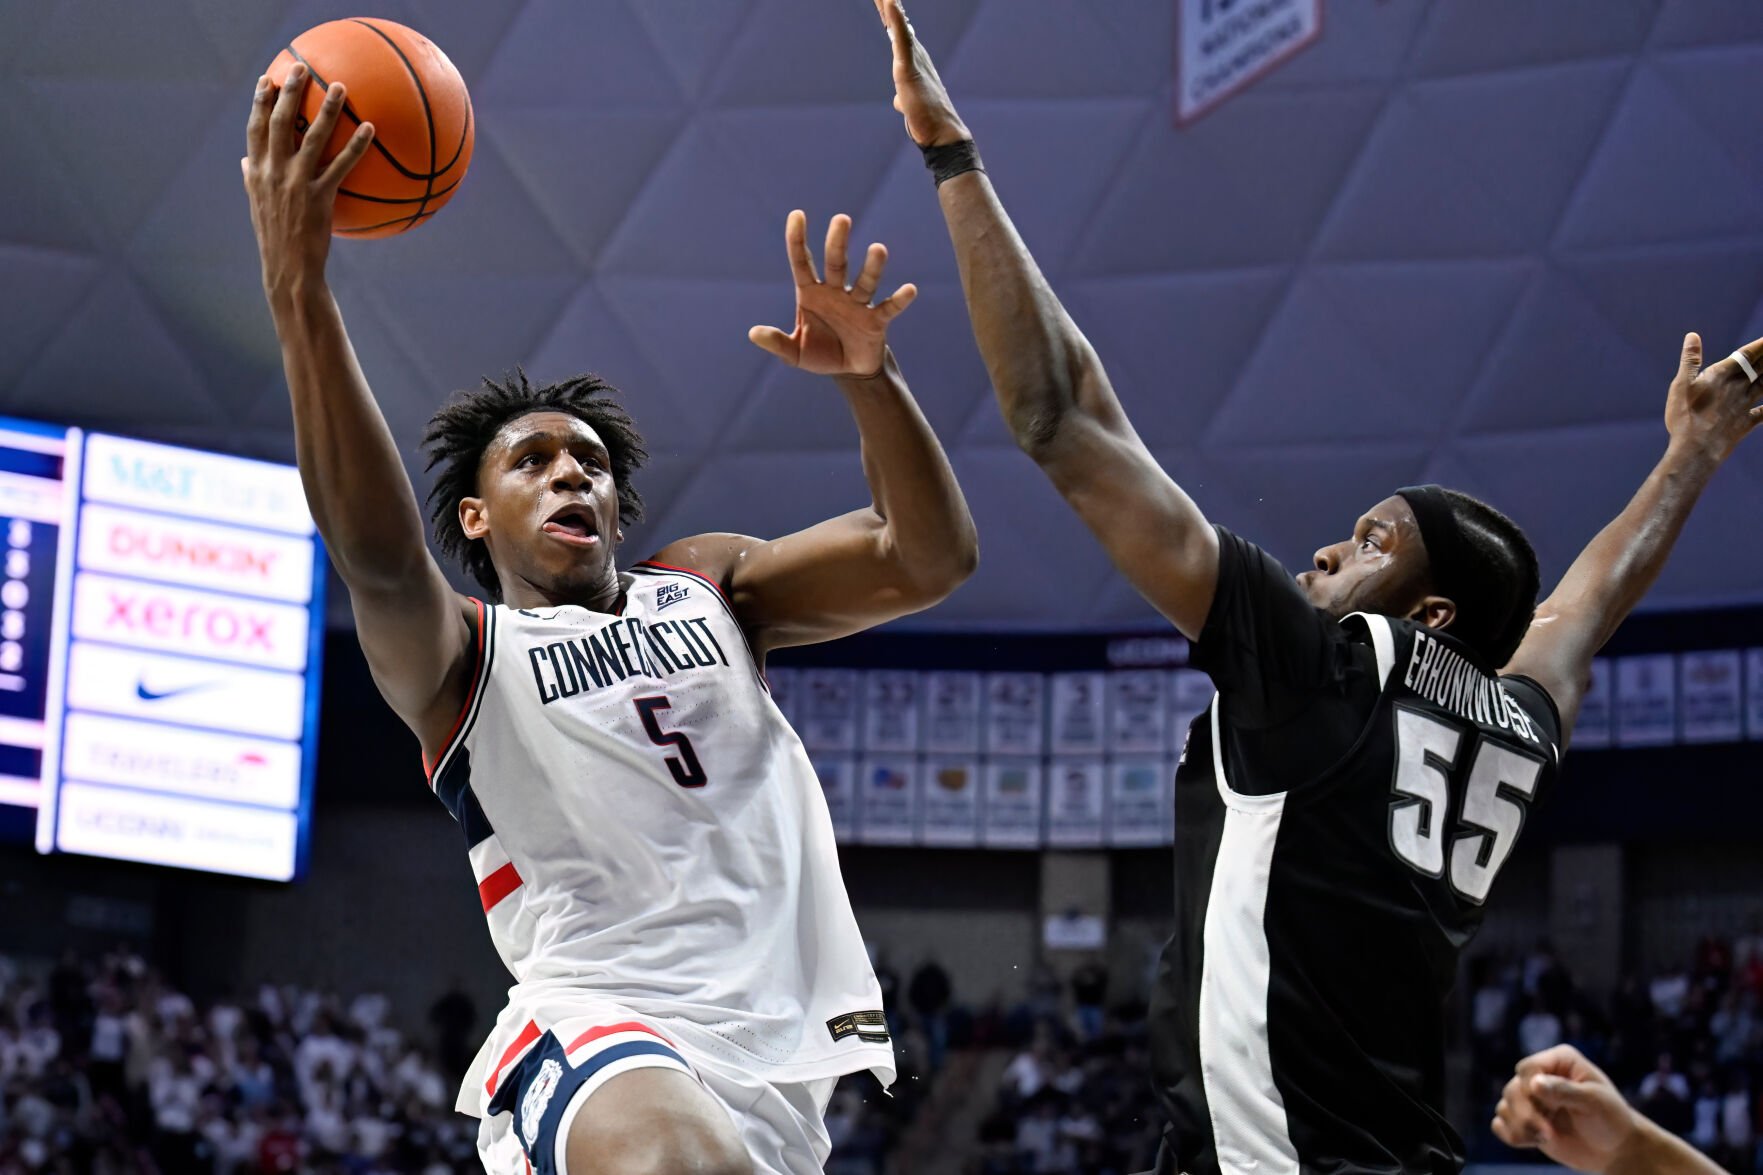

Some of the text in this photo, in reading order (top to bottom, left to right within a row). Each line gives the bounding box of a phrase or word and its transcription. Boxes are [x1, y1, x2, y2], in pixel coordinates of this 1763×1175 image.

[657, 582, 678, 597] BIG
[657, 587, 689, 606] EAST
[106, 590, 273, 651] xerox
[632, 695, 708, 789] 5
[1387, 701, 1548, 906] 55
